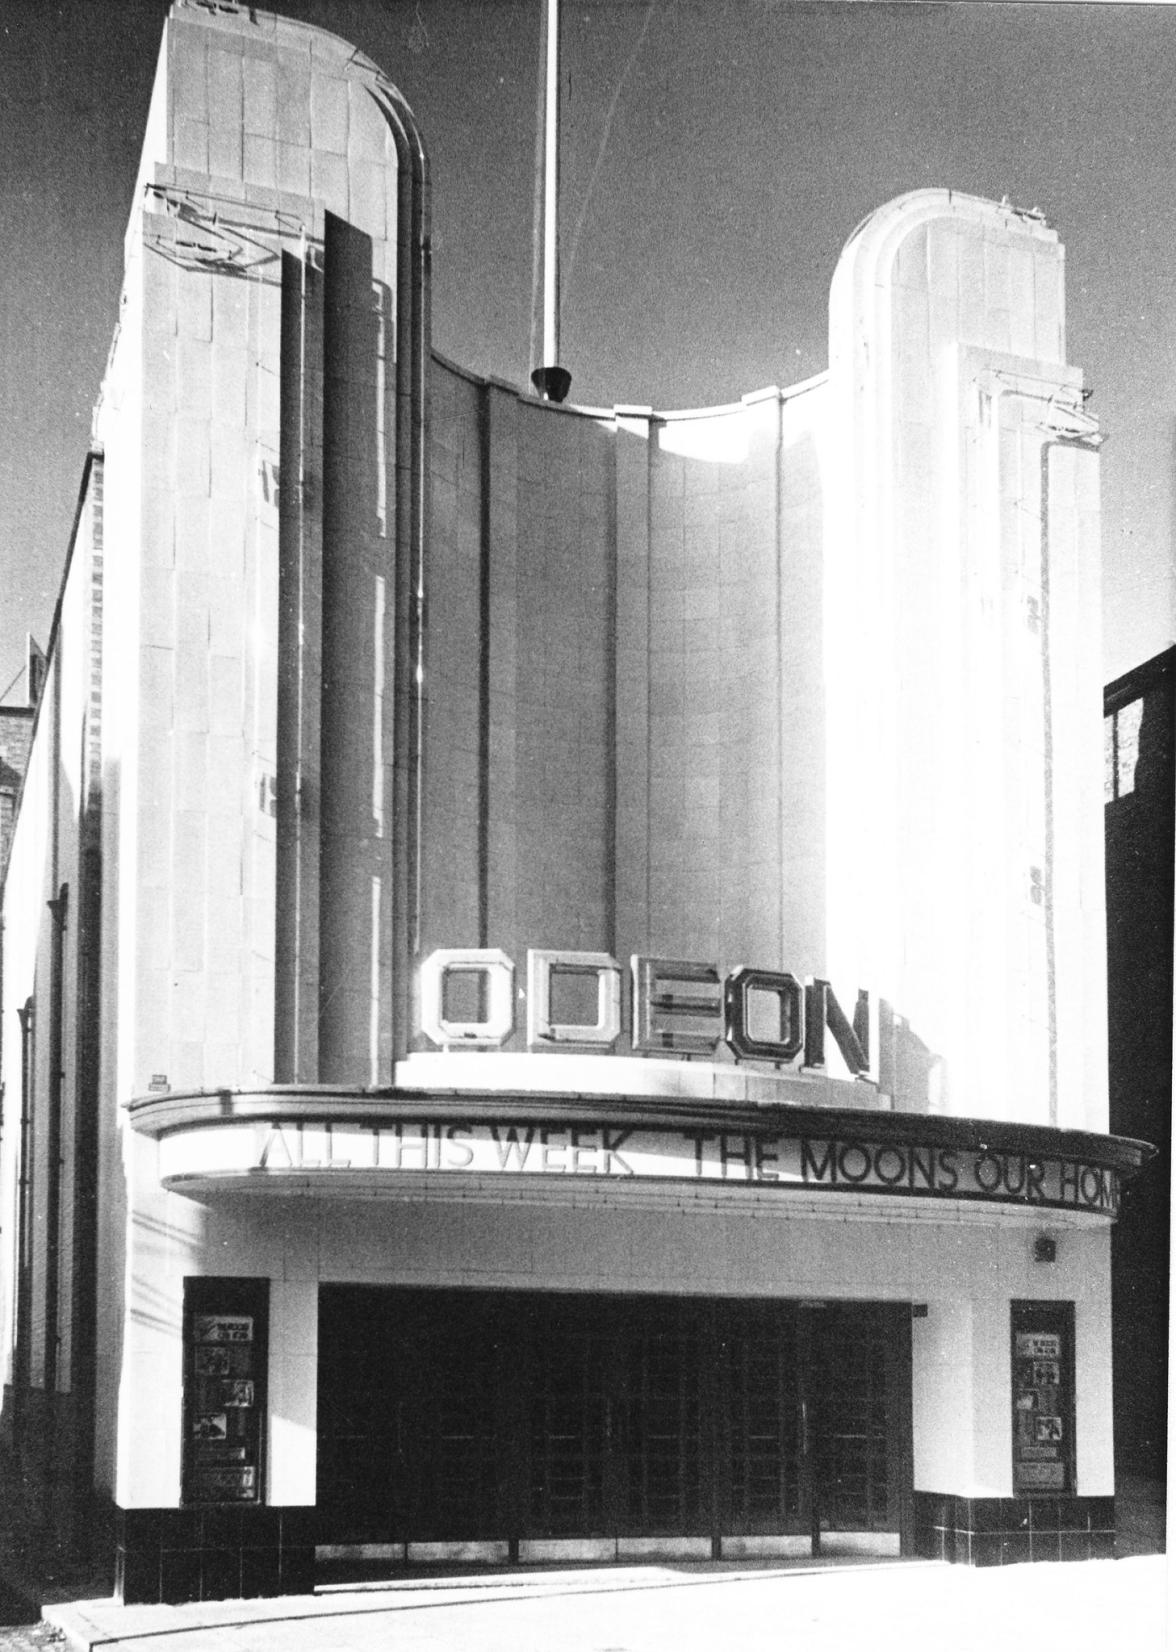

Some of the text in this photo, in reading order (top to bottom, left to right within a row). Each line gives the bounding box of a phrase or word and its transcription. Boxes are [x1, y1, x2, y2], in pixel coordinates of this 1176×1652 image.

[423, 949, 876, 1081] ODEON
[261, 1122, 351, 1169] ALL
[359, 1122, 474, 1170] THIS
[491, 1123, 634, 1175] WEEK
[684, 1132, 779, 1180] THE
[801, 1138, 959, 1190] MOONS
[973, 1154, 1045, 1200] OUR
